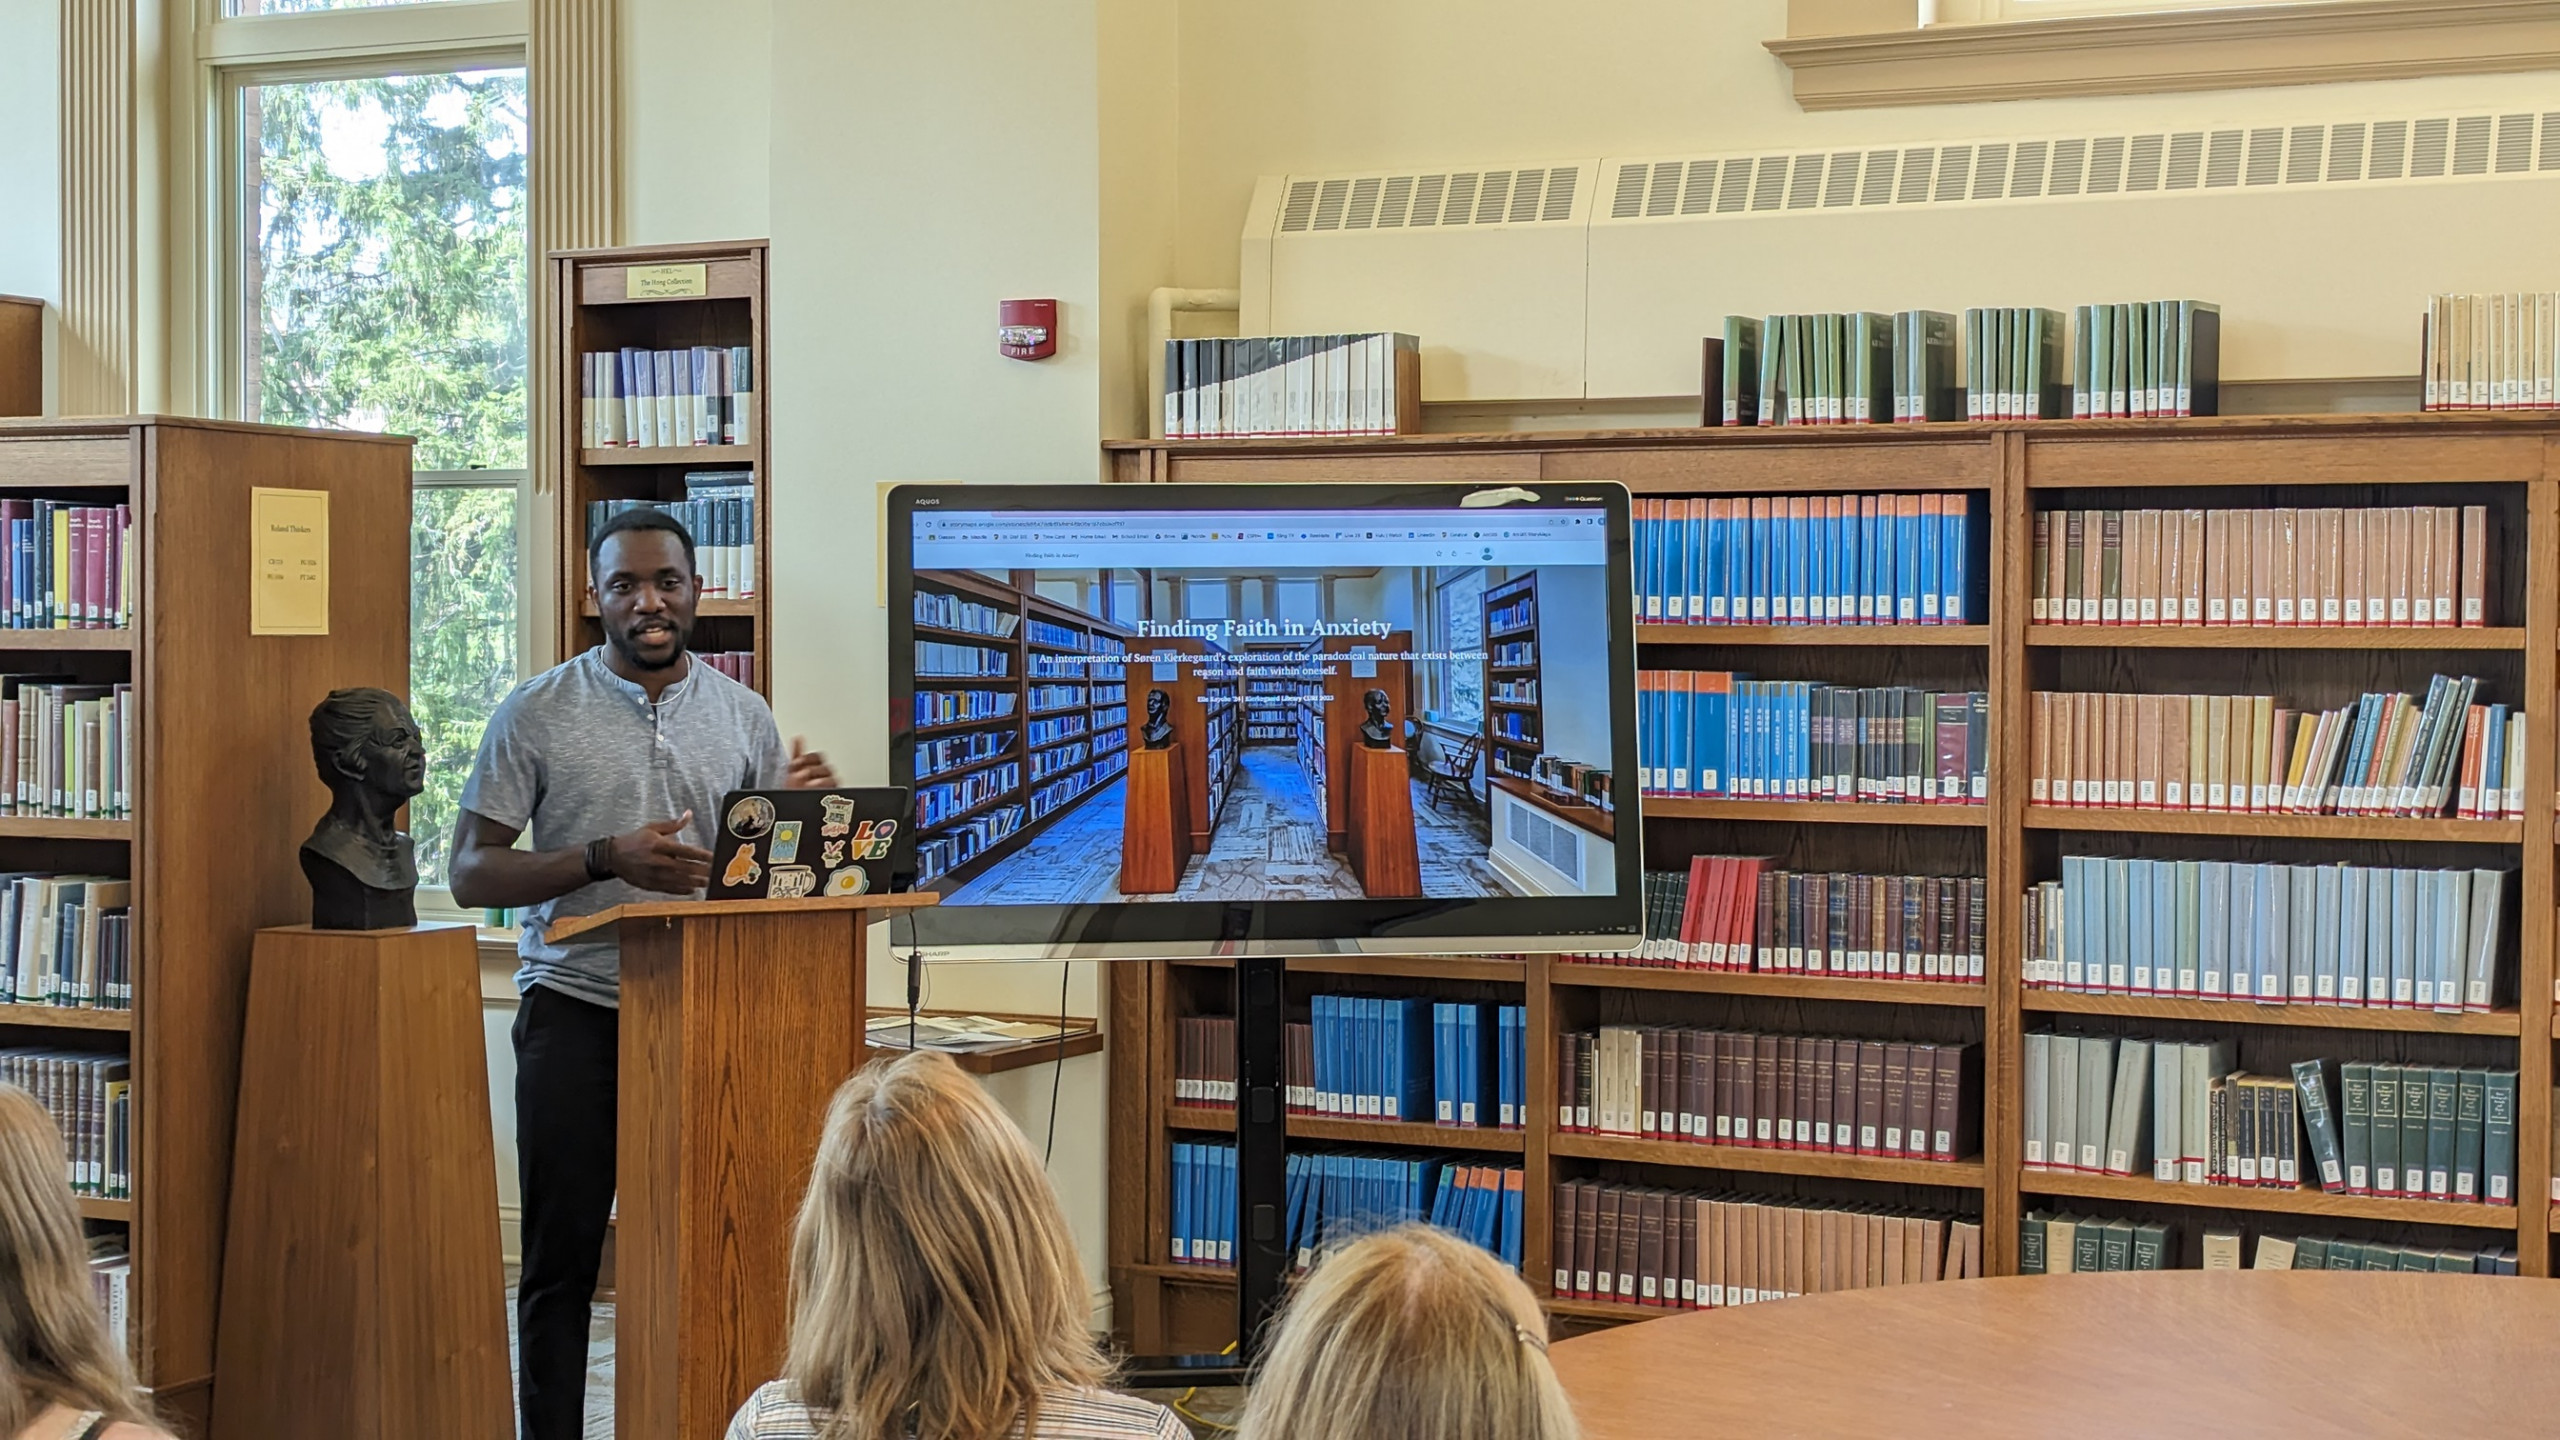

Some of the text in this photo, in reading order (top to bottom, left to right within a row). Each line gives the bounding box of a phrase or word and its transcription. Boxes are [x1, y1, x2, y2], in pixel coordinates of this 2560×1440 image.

[1010, 347, 1035, 355] FIRE
[1137, 617, 1392, 641] Finding Faith in Anxiety
[1039, 650, 1489, 665] An interpretation of Søren Kierkegaard's exploration of the paradoxical nature that exists between
[1193, 666, 1338, 676] reason and faith within oneself.
[1281, 694, 1302, 703] Library
